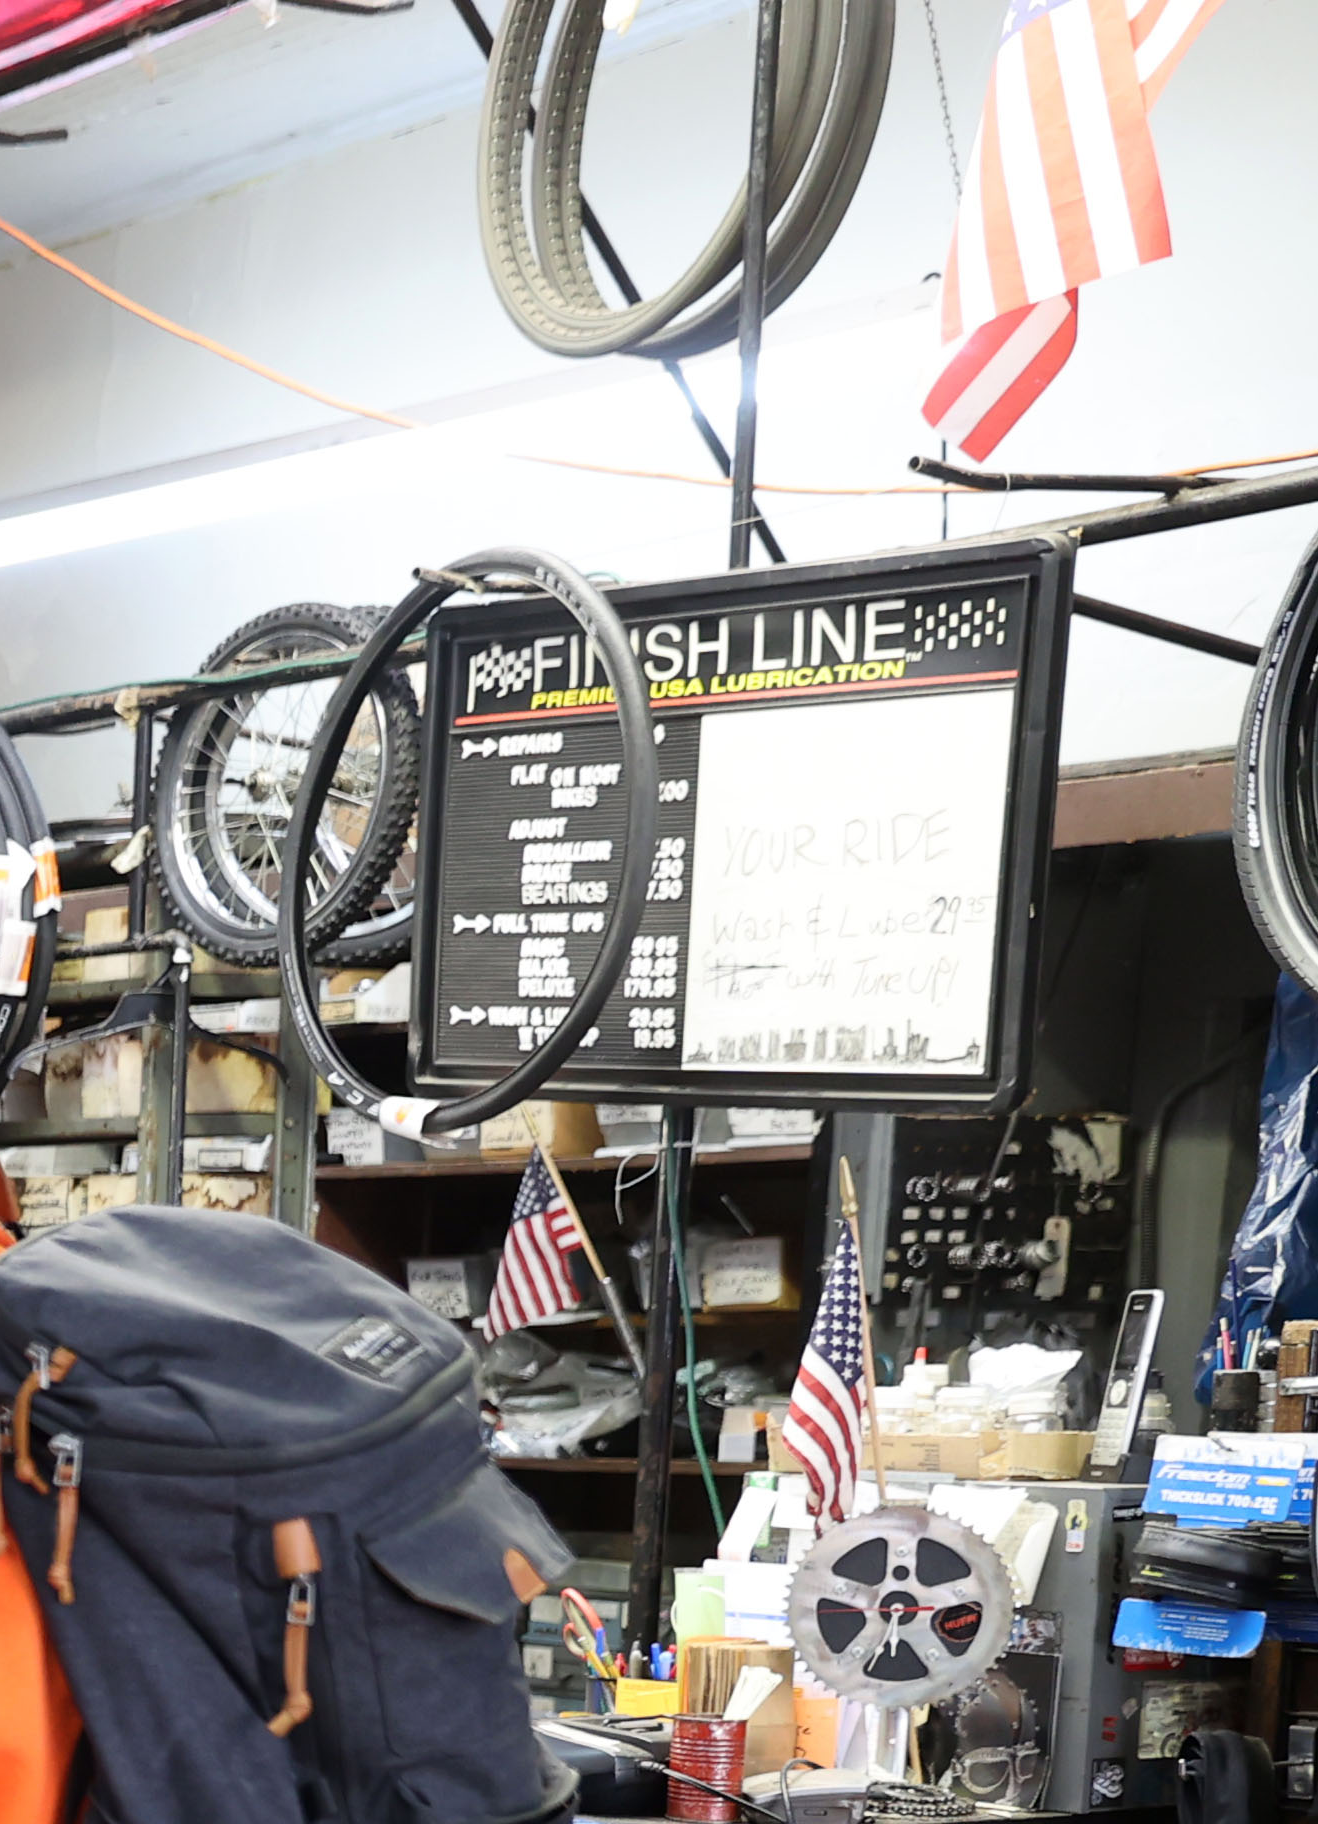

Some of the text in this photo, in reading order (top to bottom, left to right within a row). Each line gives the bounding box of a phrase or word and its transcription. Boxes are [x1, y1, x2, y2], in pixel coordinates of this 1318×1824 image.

[751, 598, 908, 672] LINE
[650, 678, 705, 700] USA
[709, 660, 908, 695] LUBRICATION
[498, 731, 564, 757] REPAIRS
[510, 763, 549, 786] FLAT
[579, 763, 622, 786] MOST
[508, 817, 569, 841] ADJUST
[521, 881, 609, 906] BEARINGS
[492, 913, 529, 934] FULL
[572, 911, 605, 934] UPS
[518, 976, 576, 999] DELUXE
[1156, 1464, 1252, 1485] Freedom
